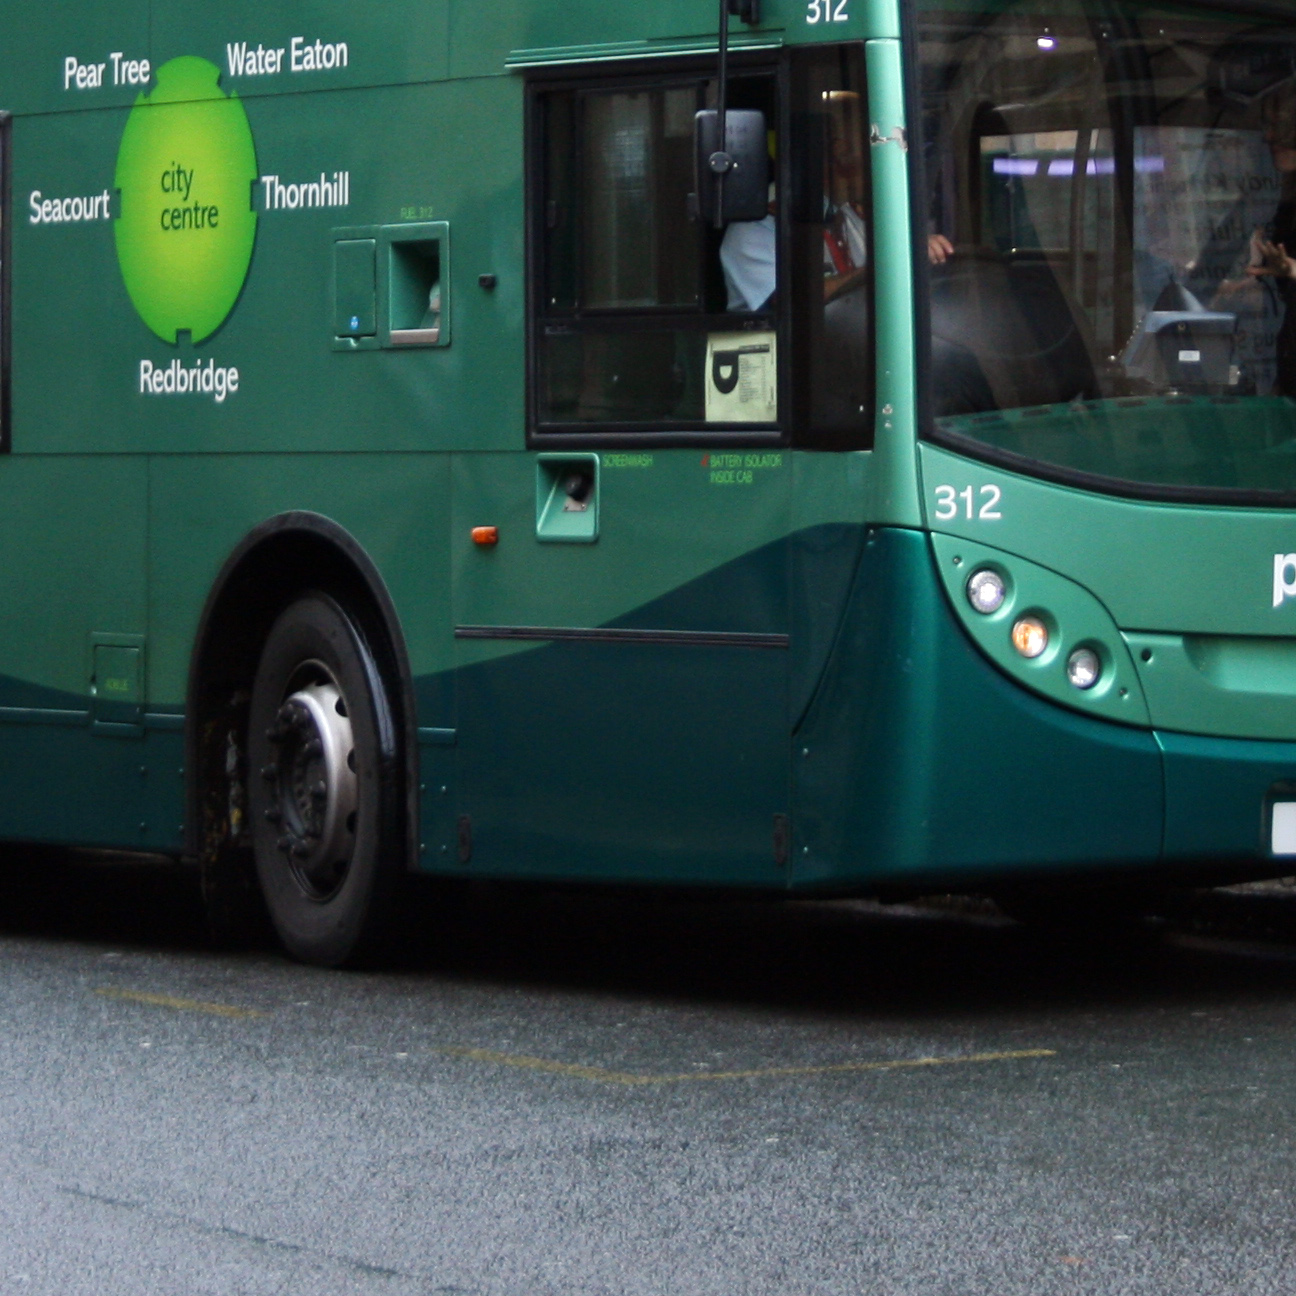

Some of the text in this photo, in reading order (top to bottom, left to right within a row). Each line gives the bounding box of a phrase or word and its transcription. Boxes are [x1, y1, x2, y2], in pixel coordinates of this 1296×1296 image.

[64, 53, 151, 90] Pear Tree
[226, 36, 348, 77] Water Eaton
[160, 161, 194, 202] city
[261, 171, 350, 210] Thornhill
[29, 190, 111, 223] Seacourt
[160, 201, 219, 231] centre
[139, 358, 239, 403] Redbridge
[934, 483, 1002, 521] 312
